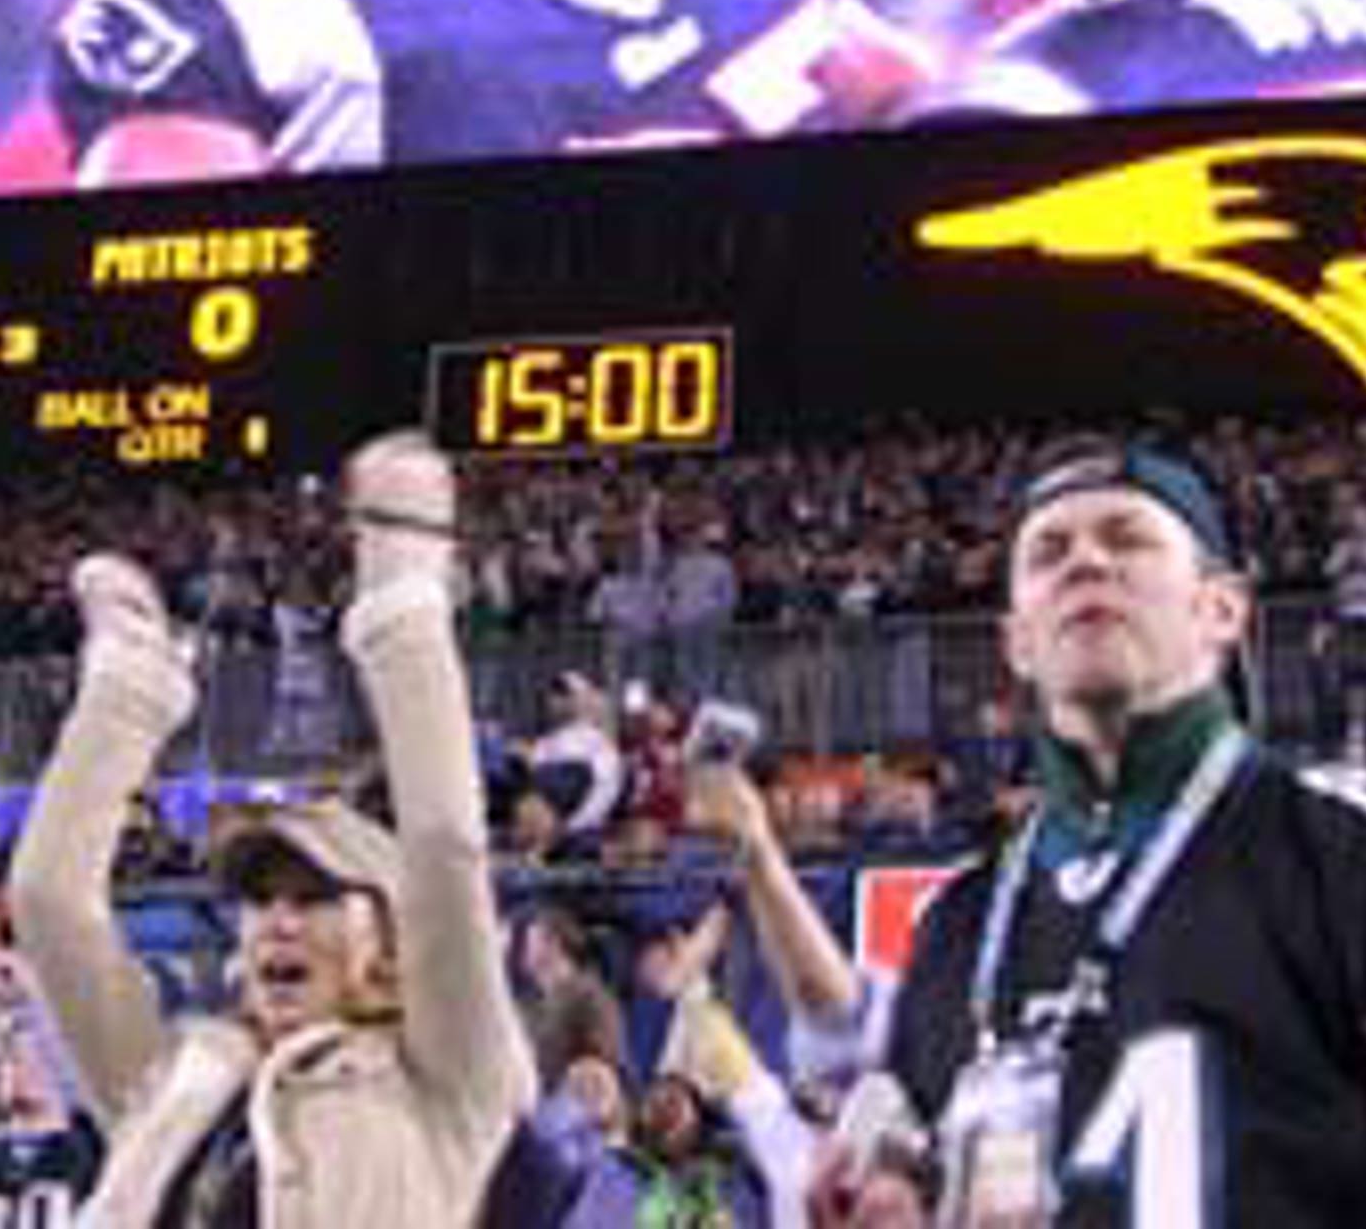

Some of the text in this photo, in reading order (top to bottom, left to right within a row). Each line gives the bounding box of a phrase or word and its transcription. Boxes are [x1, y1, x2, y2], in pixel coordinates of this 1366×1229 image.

[90, 228, 313, 284] PATRIOTS
[188, 288, 257, 360] 0
[37, 382, 212, 430] BALL ON
[477, 341, 717, 444] 15:00
[117, 426, 204, 463] QTR
